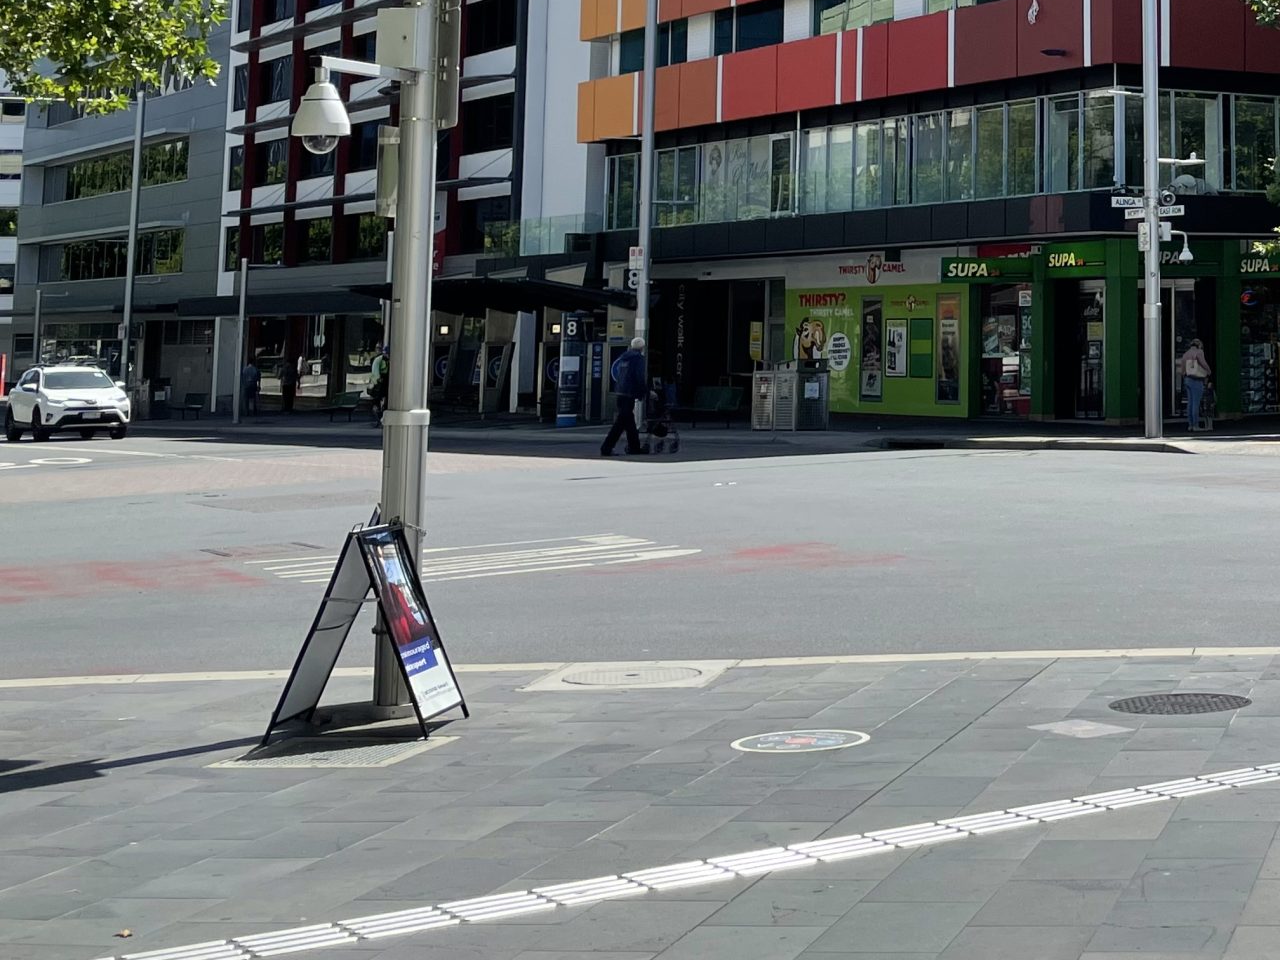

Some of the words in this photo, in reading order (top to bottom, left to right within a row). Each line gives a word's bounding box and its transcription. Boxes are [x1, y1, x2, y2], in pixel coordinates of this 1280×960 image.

[1115, 198, 1137, 206] ALINGA
[1159, 207, 1171, 215] EAST
[1048, 252, 1076, 267] SUPA
[1240, 258, 1270, 273] SUPA
[839, 265, 865, 275] THIRSTY
[882, 263, 906, 273] CAMEL
[947, 263, 988, 277] SUPA
[799, 292, 846, 307] THIRSTY?
[567, 321, 577, 336] 8
[112, 352, 119, 362] 7
